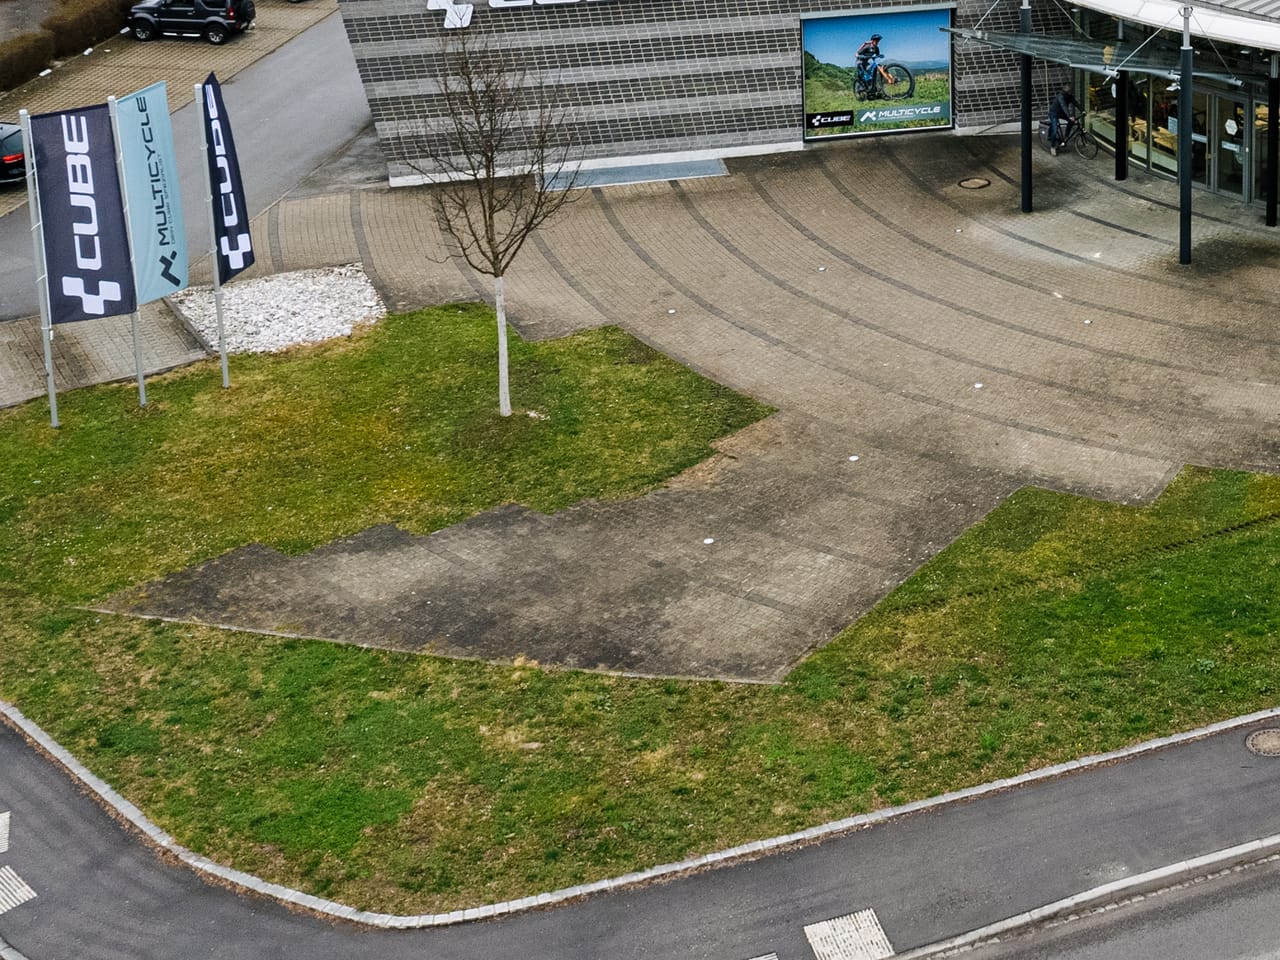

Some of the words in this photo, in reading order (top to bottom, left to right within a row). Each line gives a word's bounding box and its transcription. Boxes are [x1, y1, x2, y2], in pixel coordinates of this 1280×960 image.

[135, 95, 171, 247] MULTICYCLE
[204, 83, 239, 227] CUBE
[820, 115, 851, 123] CUBE
[878, 106, 941, 118] MULTICYCLE
[61, 114, 103, 270] CUBE
